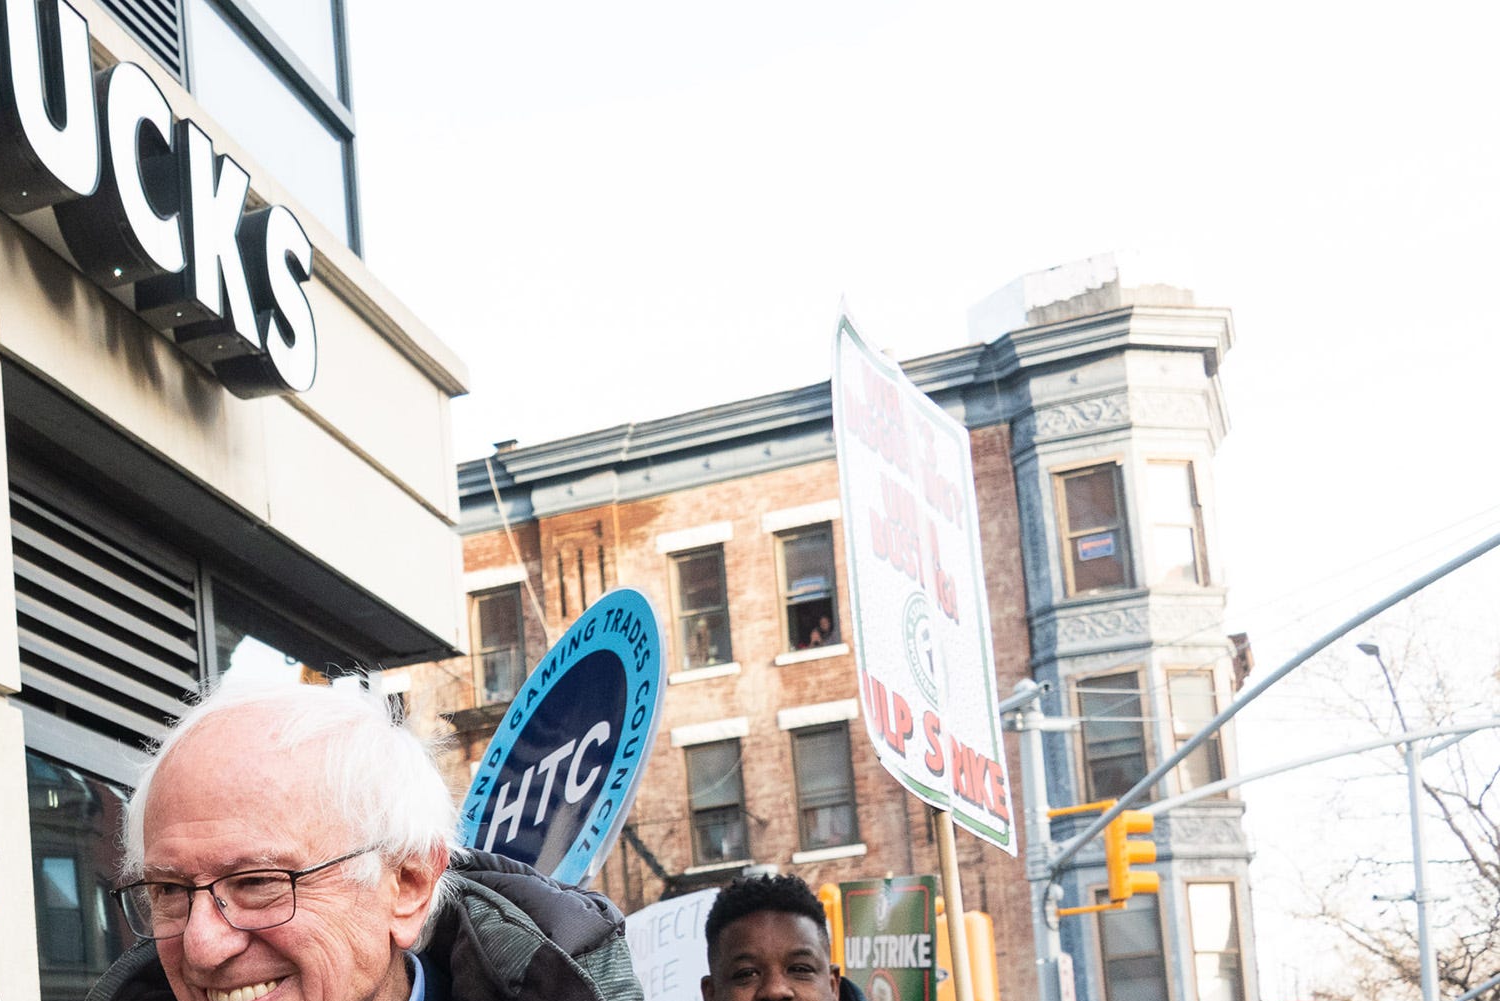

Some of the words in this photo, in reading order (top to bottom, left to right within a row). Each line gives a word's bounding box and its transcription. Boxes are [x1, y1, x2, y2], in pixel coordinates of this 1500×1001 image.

[509, 618, 597, 731] GAMING
[602, 607, 652, 673] TRADES
[466, 746, 503, 822] AND
[482, 720, 611, 852] HTC
[577, 680, 650, 854] COUNCIL
[862, 670, 914, 757] ULP
[923, 710, 1010, 824] SRIKE
[845, 936, 873, 969] ULP
[872, 933, 932, 969] STRIKE
